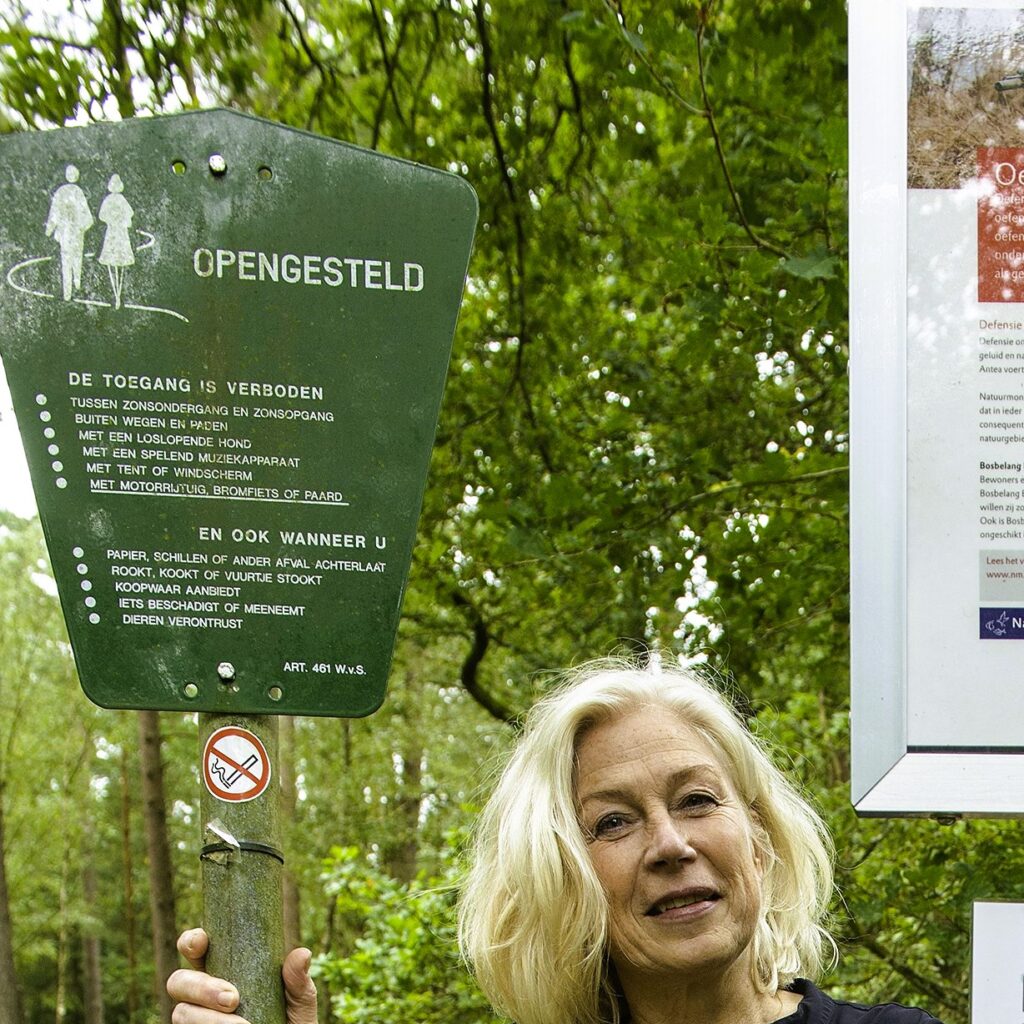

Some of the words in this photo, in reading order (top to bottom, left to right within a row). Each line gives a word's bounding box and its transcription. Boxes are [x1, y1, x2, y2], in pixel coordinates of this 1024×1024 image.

[193, 248, 424, 292] OPENGESTELD
[979, 319, 1022, 330] Defensie
[979, 365, 1002, 374] Antea
[1003, 365, 1024, 374] voert
[68, 372, 92, 388] DE
[103, 374, 190, 393] TOEGANG
[200, 379, 216, 394] IS
[227, 380, 323, 400] VERBODEN
[70, 396, 117, 410] TUSSEN
[122, 399, 228, 416] ZONSONDERGANG
[232, 405, 248, 417] EN
[253, 406, 334, 422] ZONSOPGANG
[75, 412, 117, 426] BUITEN
[122, 415, 165, 428] WEGEN
[169, 417, 185, 429] EN
[190, 418, 228, 431] PADEN
[78, 430, 104, 442] MET
[108, 431, 132, 443] EEN
[136, 432, 213, 447] LOSLOPENDE
[218, 436, 252, 449] HOND
[82, 446, 108, 459] MET
[112, 447, 136, 460] EEN
[140, 449, 193, 463] SPELEND
[198, 451, 300, 468] MUZIEKAPPARAAT
[86, 462, 111, 475] MET
[118, 463, 146, 476] TENT
[152, 465, 168, 477] OF
[173, 466, 253, 481] WINDSCHERM
[979, 461, 1021, 473] Bosbelang
[90, 478, 114, 491] MET
[120, 479, 208, 497] MOTORRIJTUIG,
[213, 484, 279, 498] BROMFIETS
[283, 487, 299, 500] OF
[304, 488, 343, 502] PAARD
[979, 489, 1020, 501] Bosbelang
[199, 526, 222, 541] EN
[231, 527, 268, 543] OOK
[280, 530, 365, 548] WANNEER
[375, 534, 386, 548] U
[979, 530, 1021, 541] ongeschikt
[107, 548, 149, 563] PAPIER,
[153, 550, 208, 564] SCHILLEN
[212, 553, 227, 565] OF
[232, 554, 270, 567] ANDER
[275, 556, 310, 569] AFVAL
[315, 558, 385, 572] ACHTERLAAT
[986, 556, 1004, 565] Lees
[1005, 556, 1018, 565] het
[111, 566, 155, 580] ROOKT,
[159, 567, 198, 580] KOOKT
[203, 569, 219, 581] OF
[224, 570, 272, 583] VUURTJE
[276, 572, 322, 585] STOOKT
[115, 581, 181, 595] KOOPWAAR
[185, 584, 240, 598] AANBIEDT
[119, 597, 143, 610] IETS
[147, 598, 218, 612] BESCHADIGT
[224, 601, 239, 613] OF
[244, 602, 305, 616] MEENEEMT
[122, 613, 164, 626] DIEREN
[168, 614, 242, 628] VERONTRUST
[283, 661, 307, 673] ART.
[312, 662, 330, 674] 461
[334, 662, 366, 675] W.v.S.
